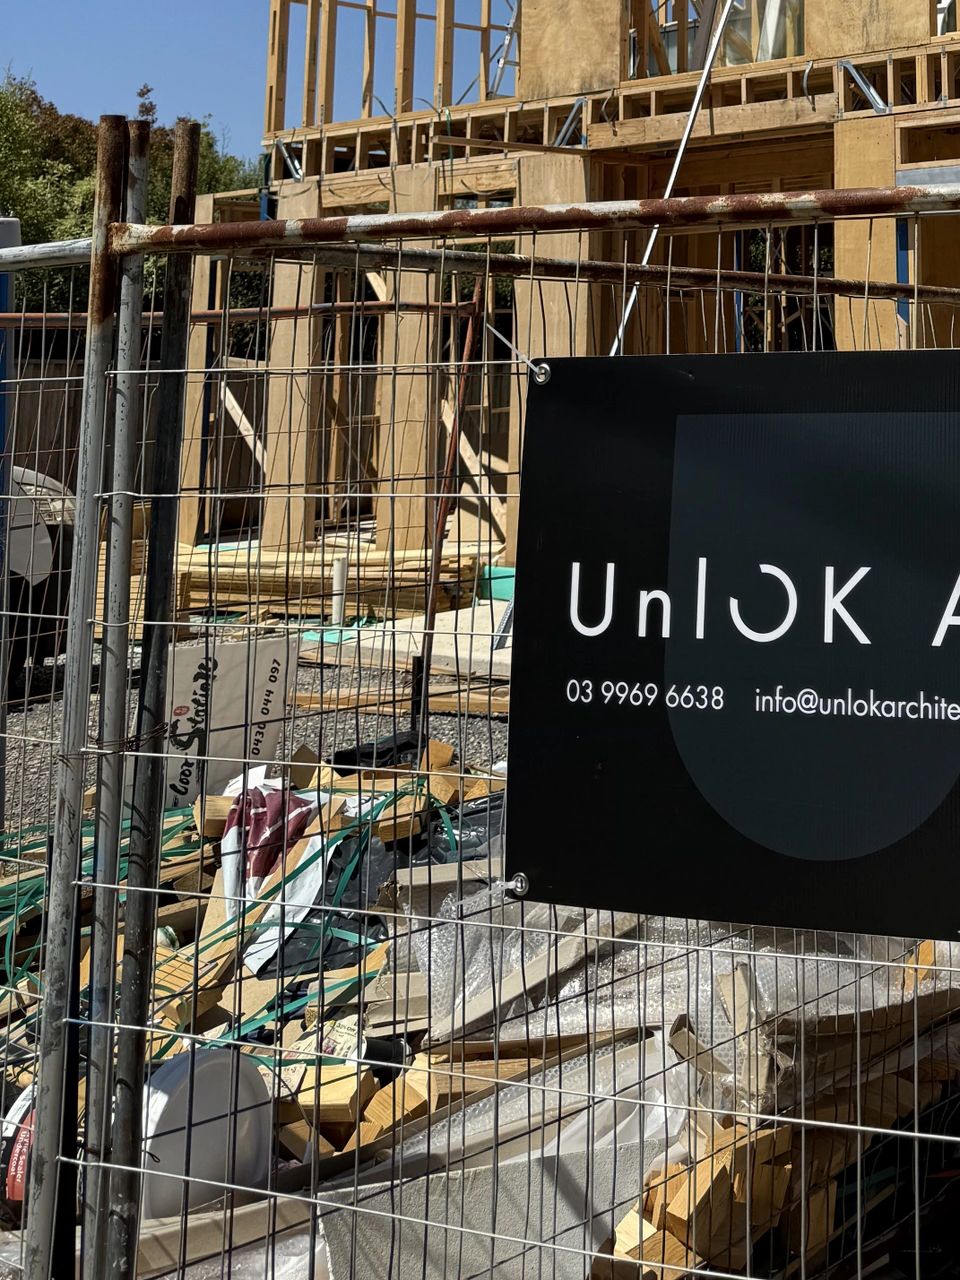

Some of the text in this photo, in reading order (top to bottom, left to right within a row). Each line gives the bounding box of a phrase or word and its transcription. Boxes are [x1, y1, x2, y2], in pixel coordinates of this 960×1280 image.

[251, 658, 282, 757] 0430 044 097
[566, 679, 724, 710] 03 9969 6638
[10, 1130, 27, 1176] Undercoat
[16, 1154, 26, 1183] Sealer
